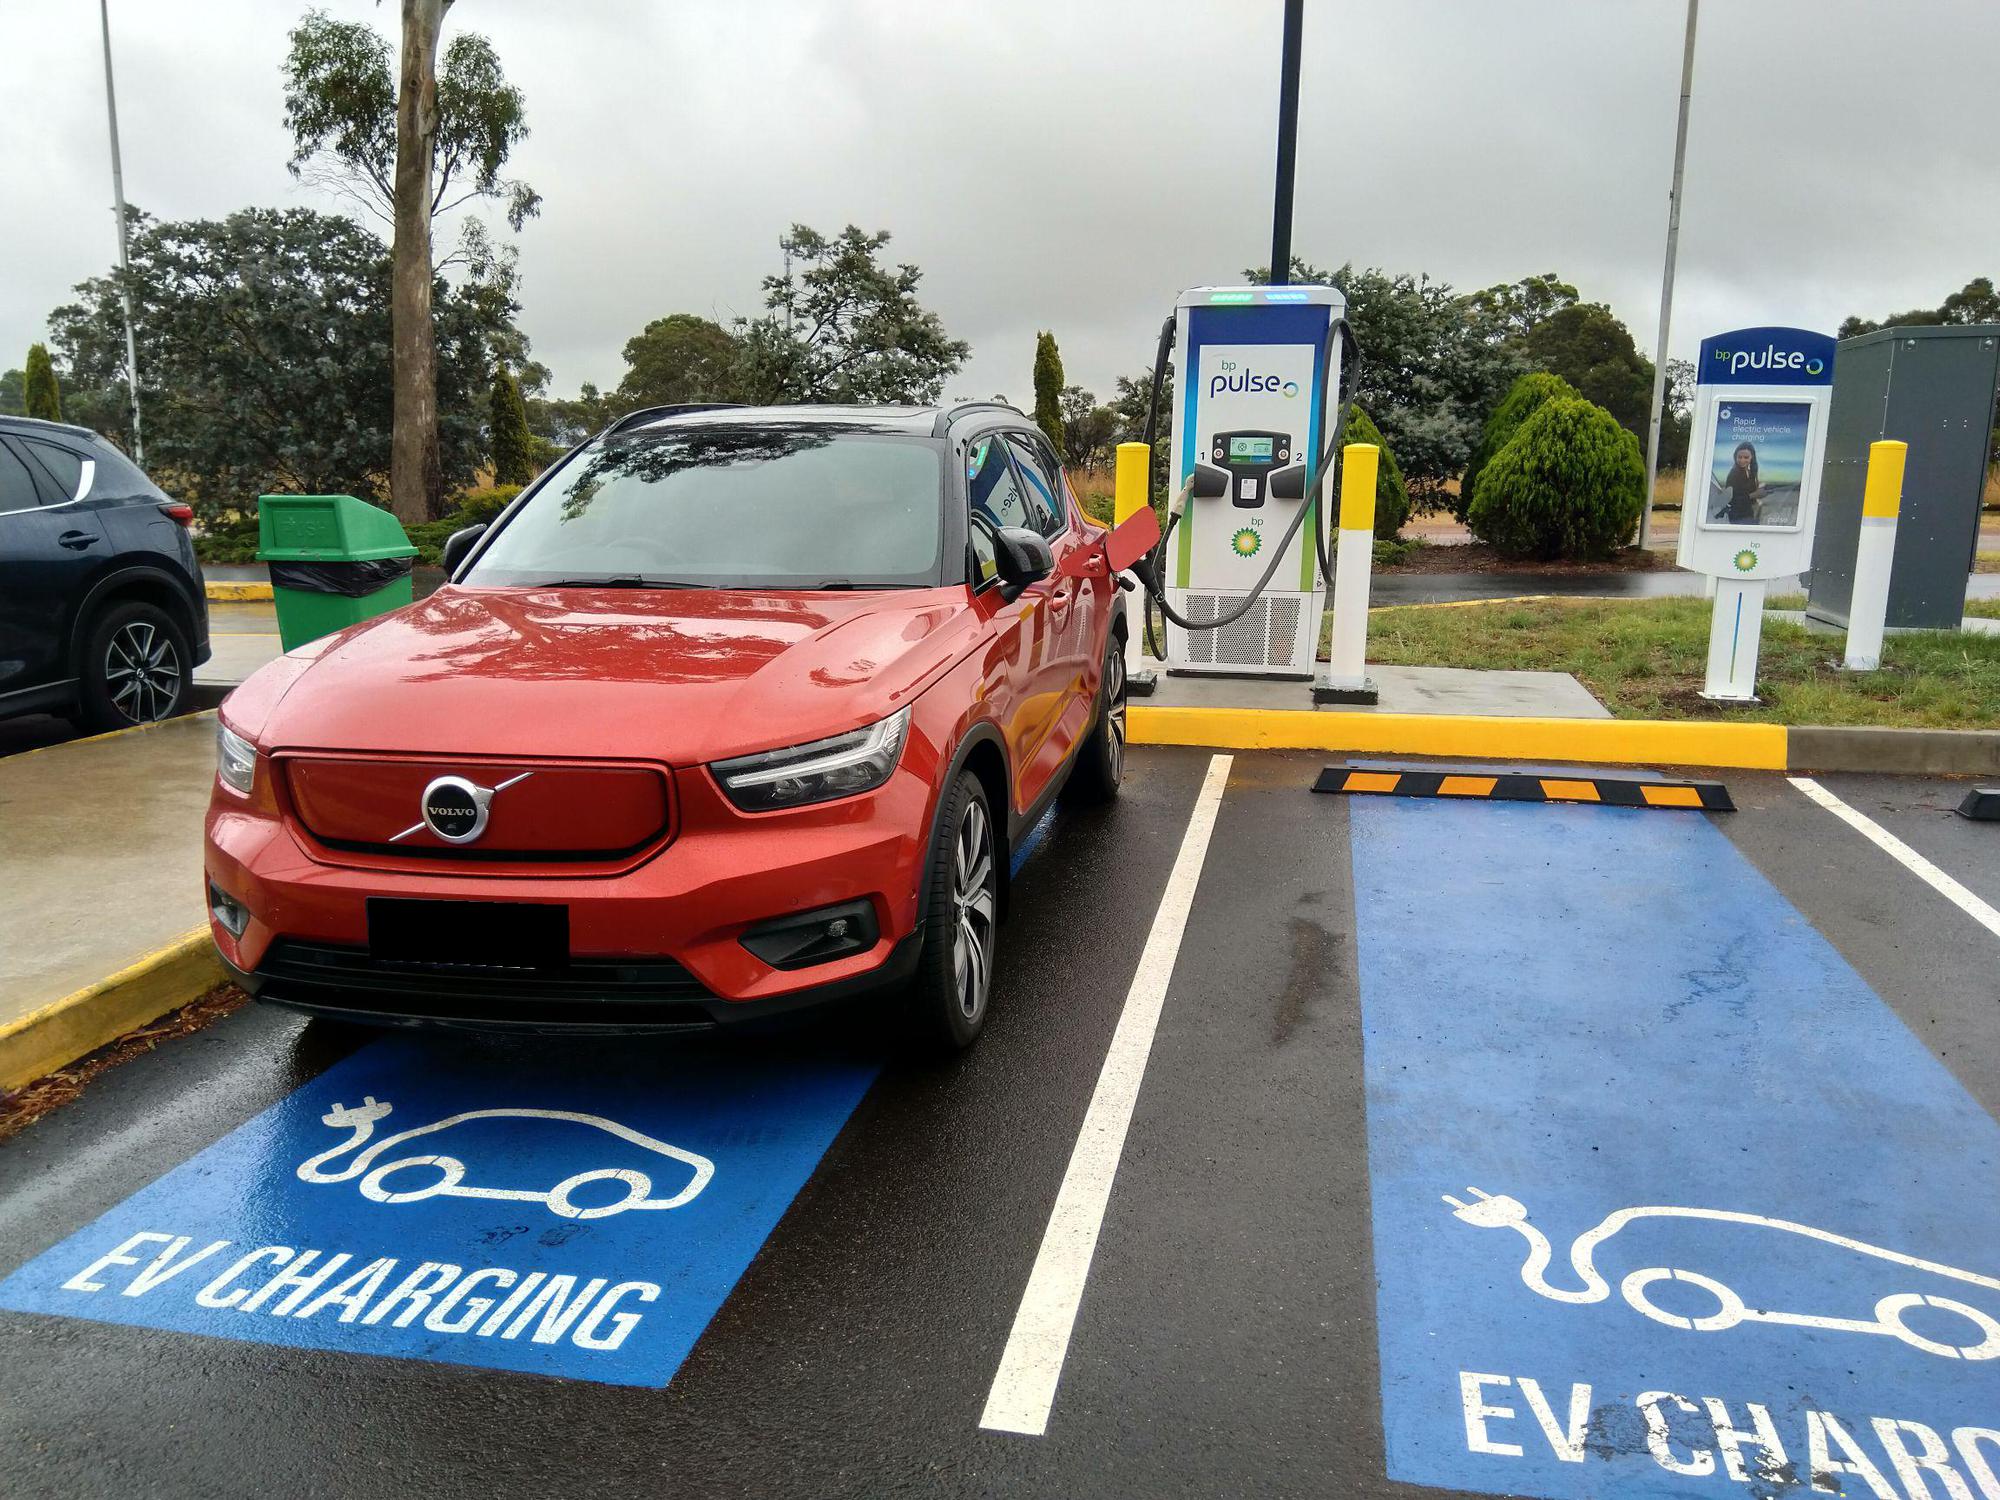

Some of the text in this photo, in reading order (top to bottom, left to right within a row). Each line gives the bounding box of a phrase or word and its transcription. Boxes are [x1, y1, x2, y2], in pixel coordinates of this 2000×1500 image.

[1714, 344, 1805, 375] bp pulse
[1221, 360, 1237, 372] bp
[1210, 368, 1281, 398] pulse
[1733, 417, 1756, 426] Rapid
[1732, 425, 1791, 433] electric vehicle
[1200, 451, 1205, 460] 1
[1296, 452, 1303, 462] 2
[1251, 517, 1264, 527] bp
[1750, 541, 1761, 549] bp
[428, 806, 476, 816] VOLVO
[60, 1231, 662, 1350] EV CHARGING
[1459, 1371, 1592, 1463] EV
